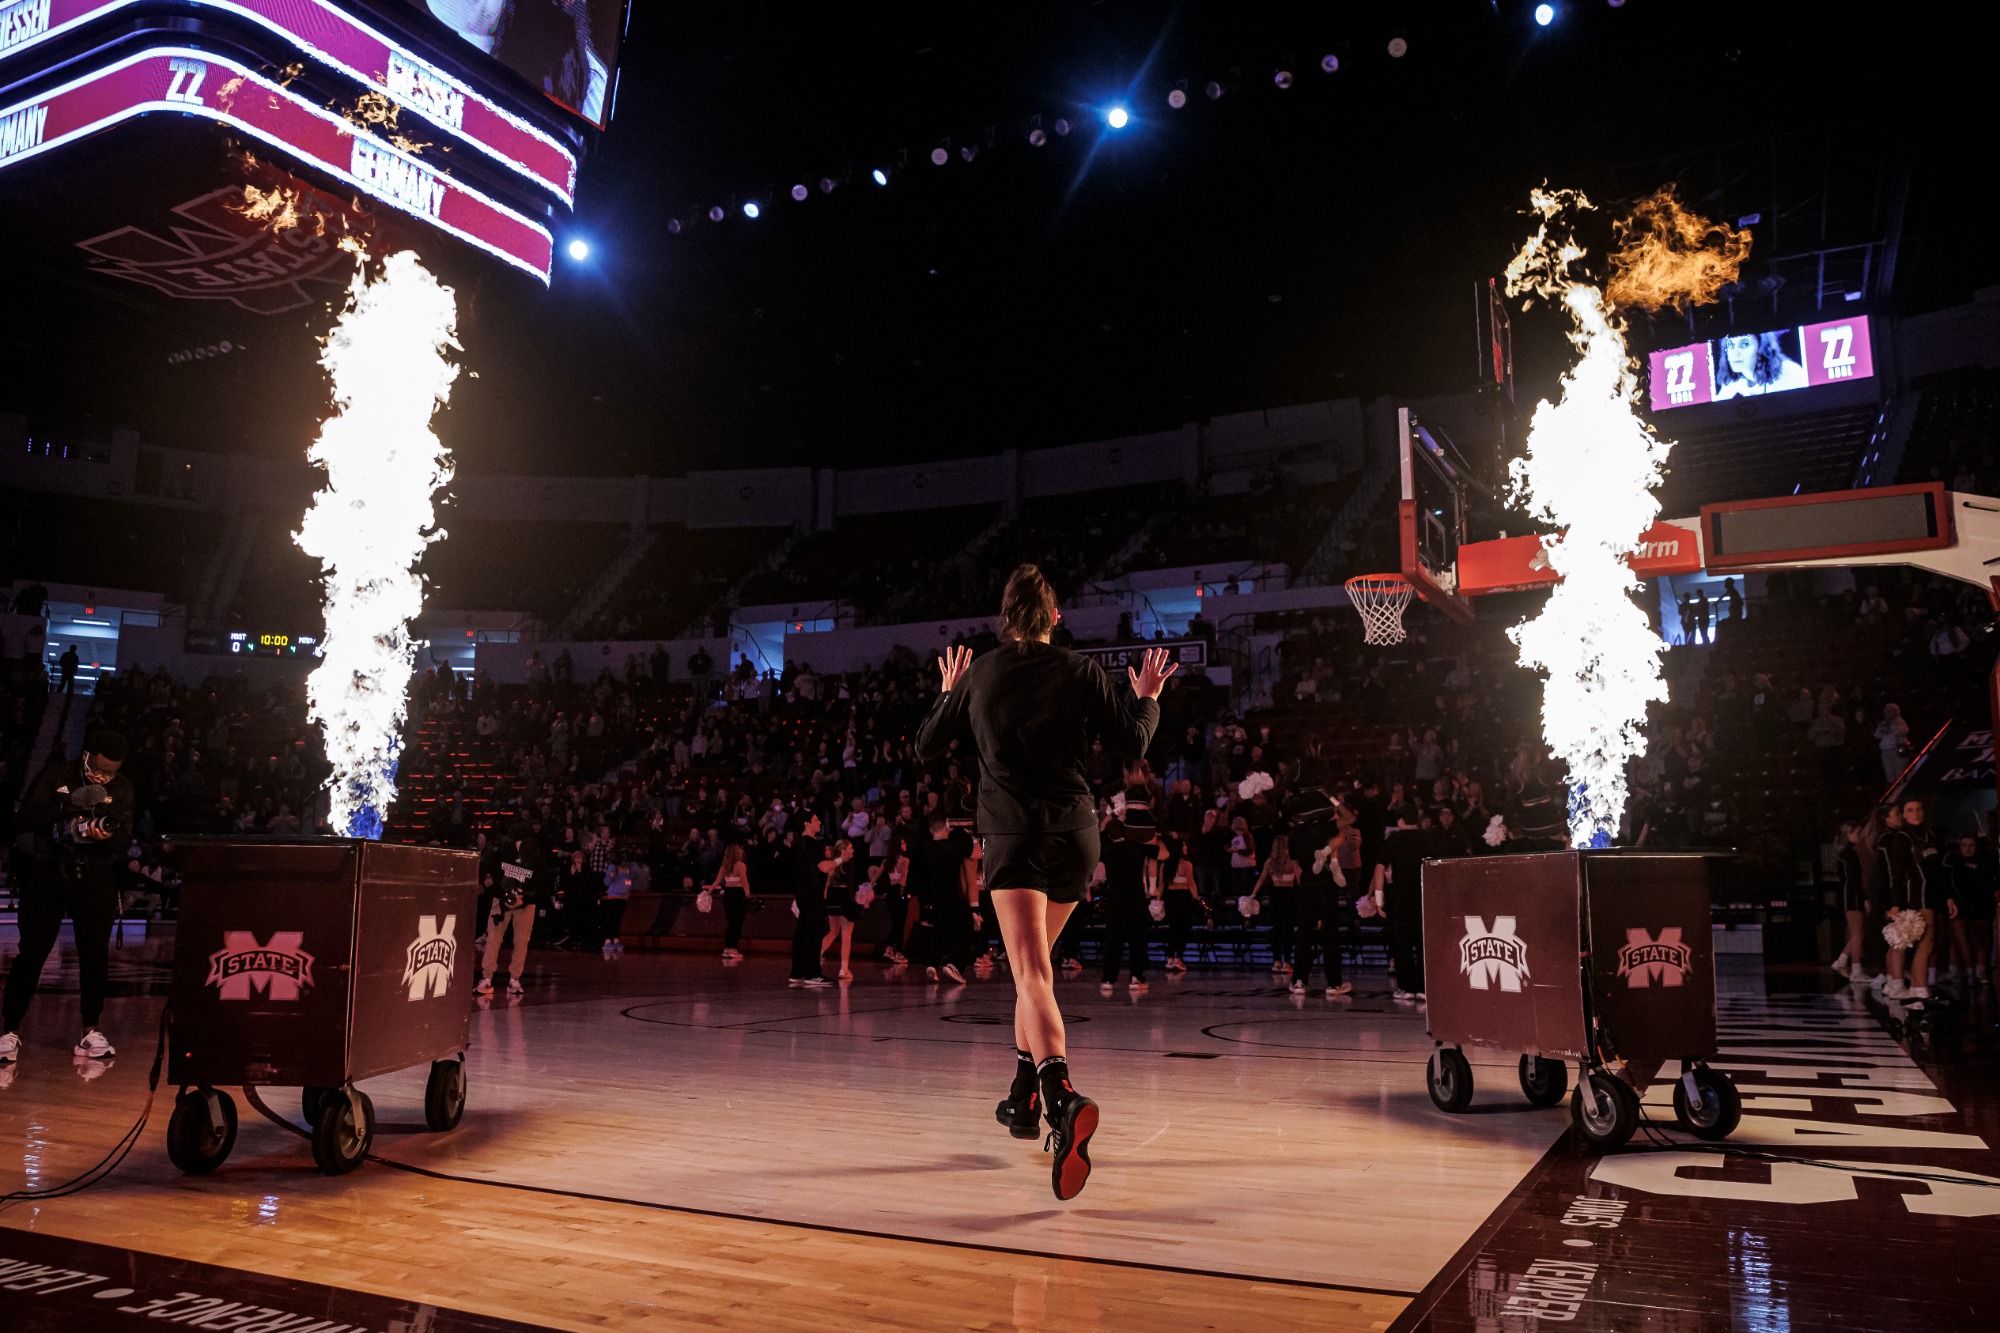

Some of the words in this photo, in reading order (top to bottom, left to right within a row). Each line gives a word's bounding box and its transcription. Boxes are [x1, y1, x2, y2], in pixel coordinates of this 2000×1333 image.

[165, 57, 207, 107] 22
[350, 137, 446, 219] GERMANY
[1820, 324, 1856, 369] 22
[1664, 350, 1696, 395] 22
[232, 642, 240, 653] 0
[261, 635, 289, 646] 10:00
[227, 951, 295, 973] STATE
[415, 939, 452, 970] STATE
[1469, 938, 1516, 962] STATE
[1631, 945, 1679, 966] STATE
[1559, 1194, 1630, 1229] JONES
[1499, 1258, 1600, 1322] KEMPER
